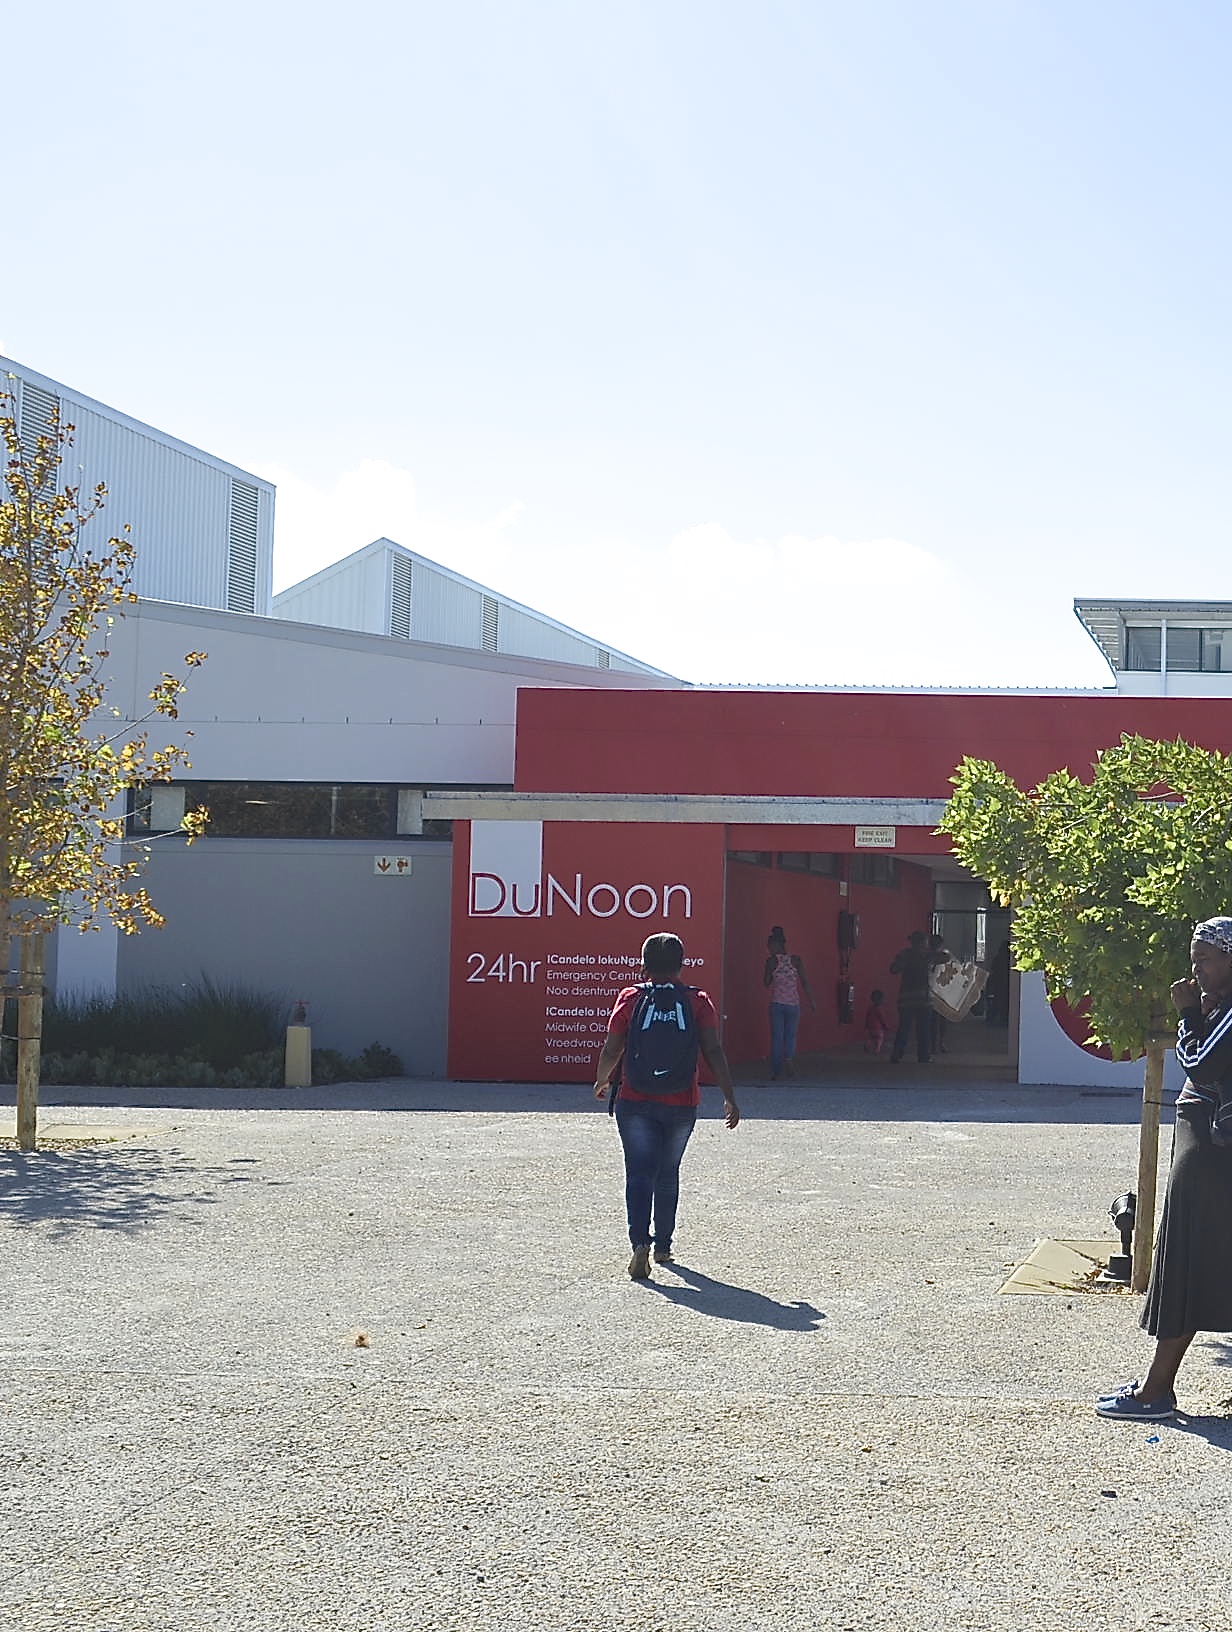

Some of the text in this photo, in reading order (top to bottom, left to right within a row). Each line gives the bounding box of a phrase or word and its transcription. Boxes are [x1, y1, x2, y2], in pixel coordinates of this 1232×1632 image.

[468, 873, 692, 918] DuNoon
[546, 954, 595, 965] ICandelo
[465, 953, 542, 983] 24hr
[546, 970, 606, 982] Emergency
[545, 1006, 595, 1017] ICandelo
[545, 1022, 587, 1033] Midwife
